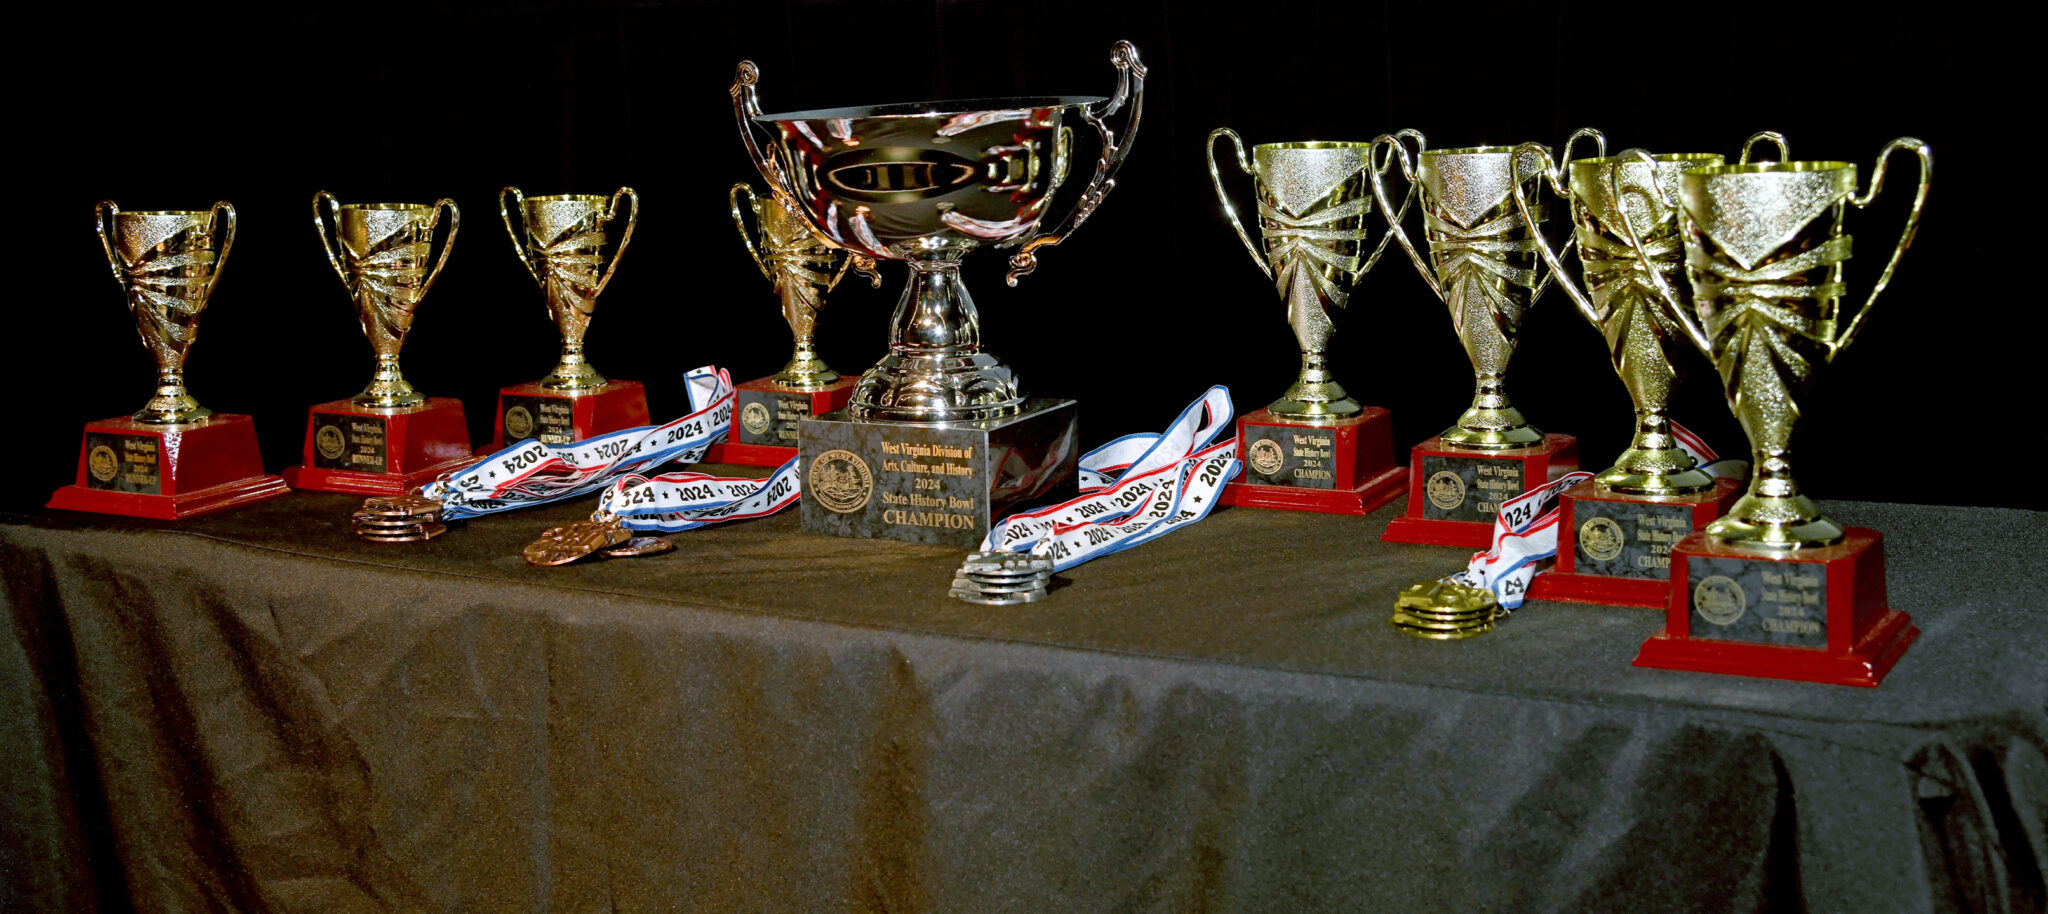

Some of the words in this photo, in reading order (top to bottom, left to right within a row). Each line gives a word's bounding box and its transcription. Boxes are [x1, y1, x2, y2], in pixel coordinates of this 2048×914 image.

[713, 403, 731, 426] 2024
[667, 420, 703, 444] 2024
[1293, 434, 1307, 445] West
[1308, 435, 1330, 448] Virginia
[594, 439, 628, 460] 2024
[881, 441, 899, 454] West
[901, 442, 931, 458] Virginia
[932, 444, 962, 458] Division
[964, 446, 973, 459] of
[502, 445, 548, 474] 2024
[1303, 459, 1321, 468] 2024
[882, 459, 899, 473] Arts,
[901, 460, 930, 475] Culture,
[931, 463, 945, 474] and
[946, 463, 973, 479] History
[1200, 459, 1228, 488] 202
[1294, 468, 1332, 480] CHAMPION
[1477, 465, 1493, 476] West
[1493, 465, 1519, 479] Virginia
[676, 484, 715, 501] 2024
[726, 483, 760, 497] 2024
[767, 476, 792, 506] 2024
[915, 478, 941, 490] 2024
[882, 491, 908, 505] State
[910, 493, 946, 510] History
[949, 496, 975, 510] Bowl
[1115, 483, 1153, 508] 2024
[1148, 479, 1175, 518] 2024
[1488, 492, 1508, 501] 2024
[1075, 501, 1109, 518] 2024
[1477, 502, 1501, 513] CHAM
[1505, 502, 1531, 528] 024
[883, 509, 975, 530] CHAMPION
[1637, 513, 1656, 526] West
[1657, 514, 1687, 529] Virginia
[1084, 527, 1114, 546] 2024
[1048, 541, 1071, 560] 024
[1638, 556, 1671, 568] CHAMP
[1778, 606, 1804, 617] 2024
[1762, 617, 1820, 634] CHAMPION
